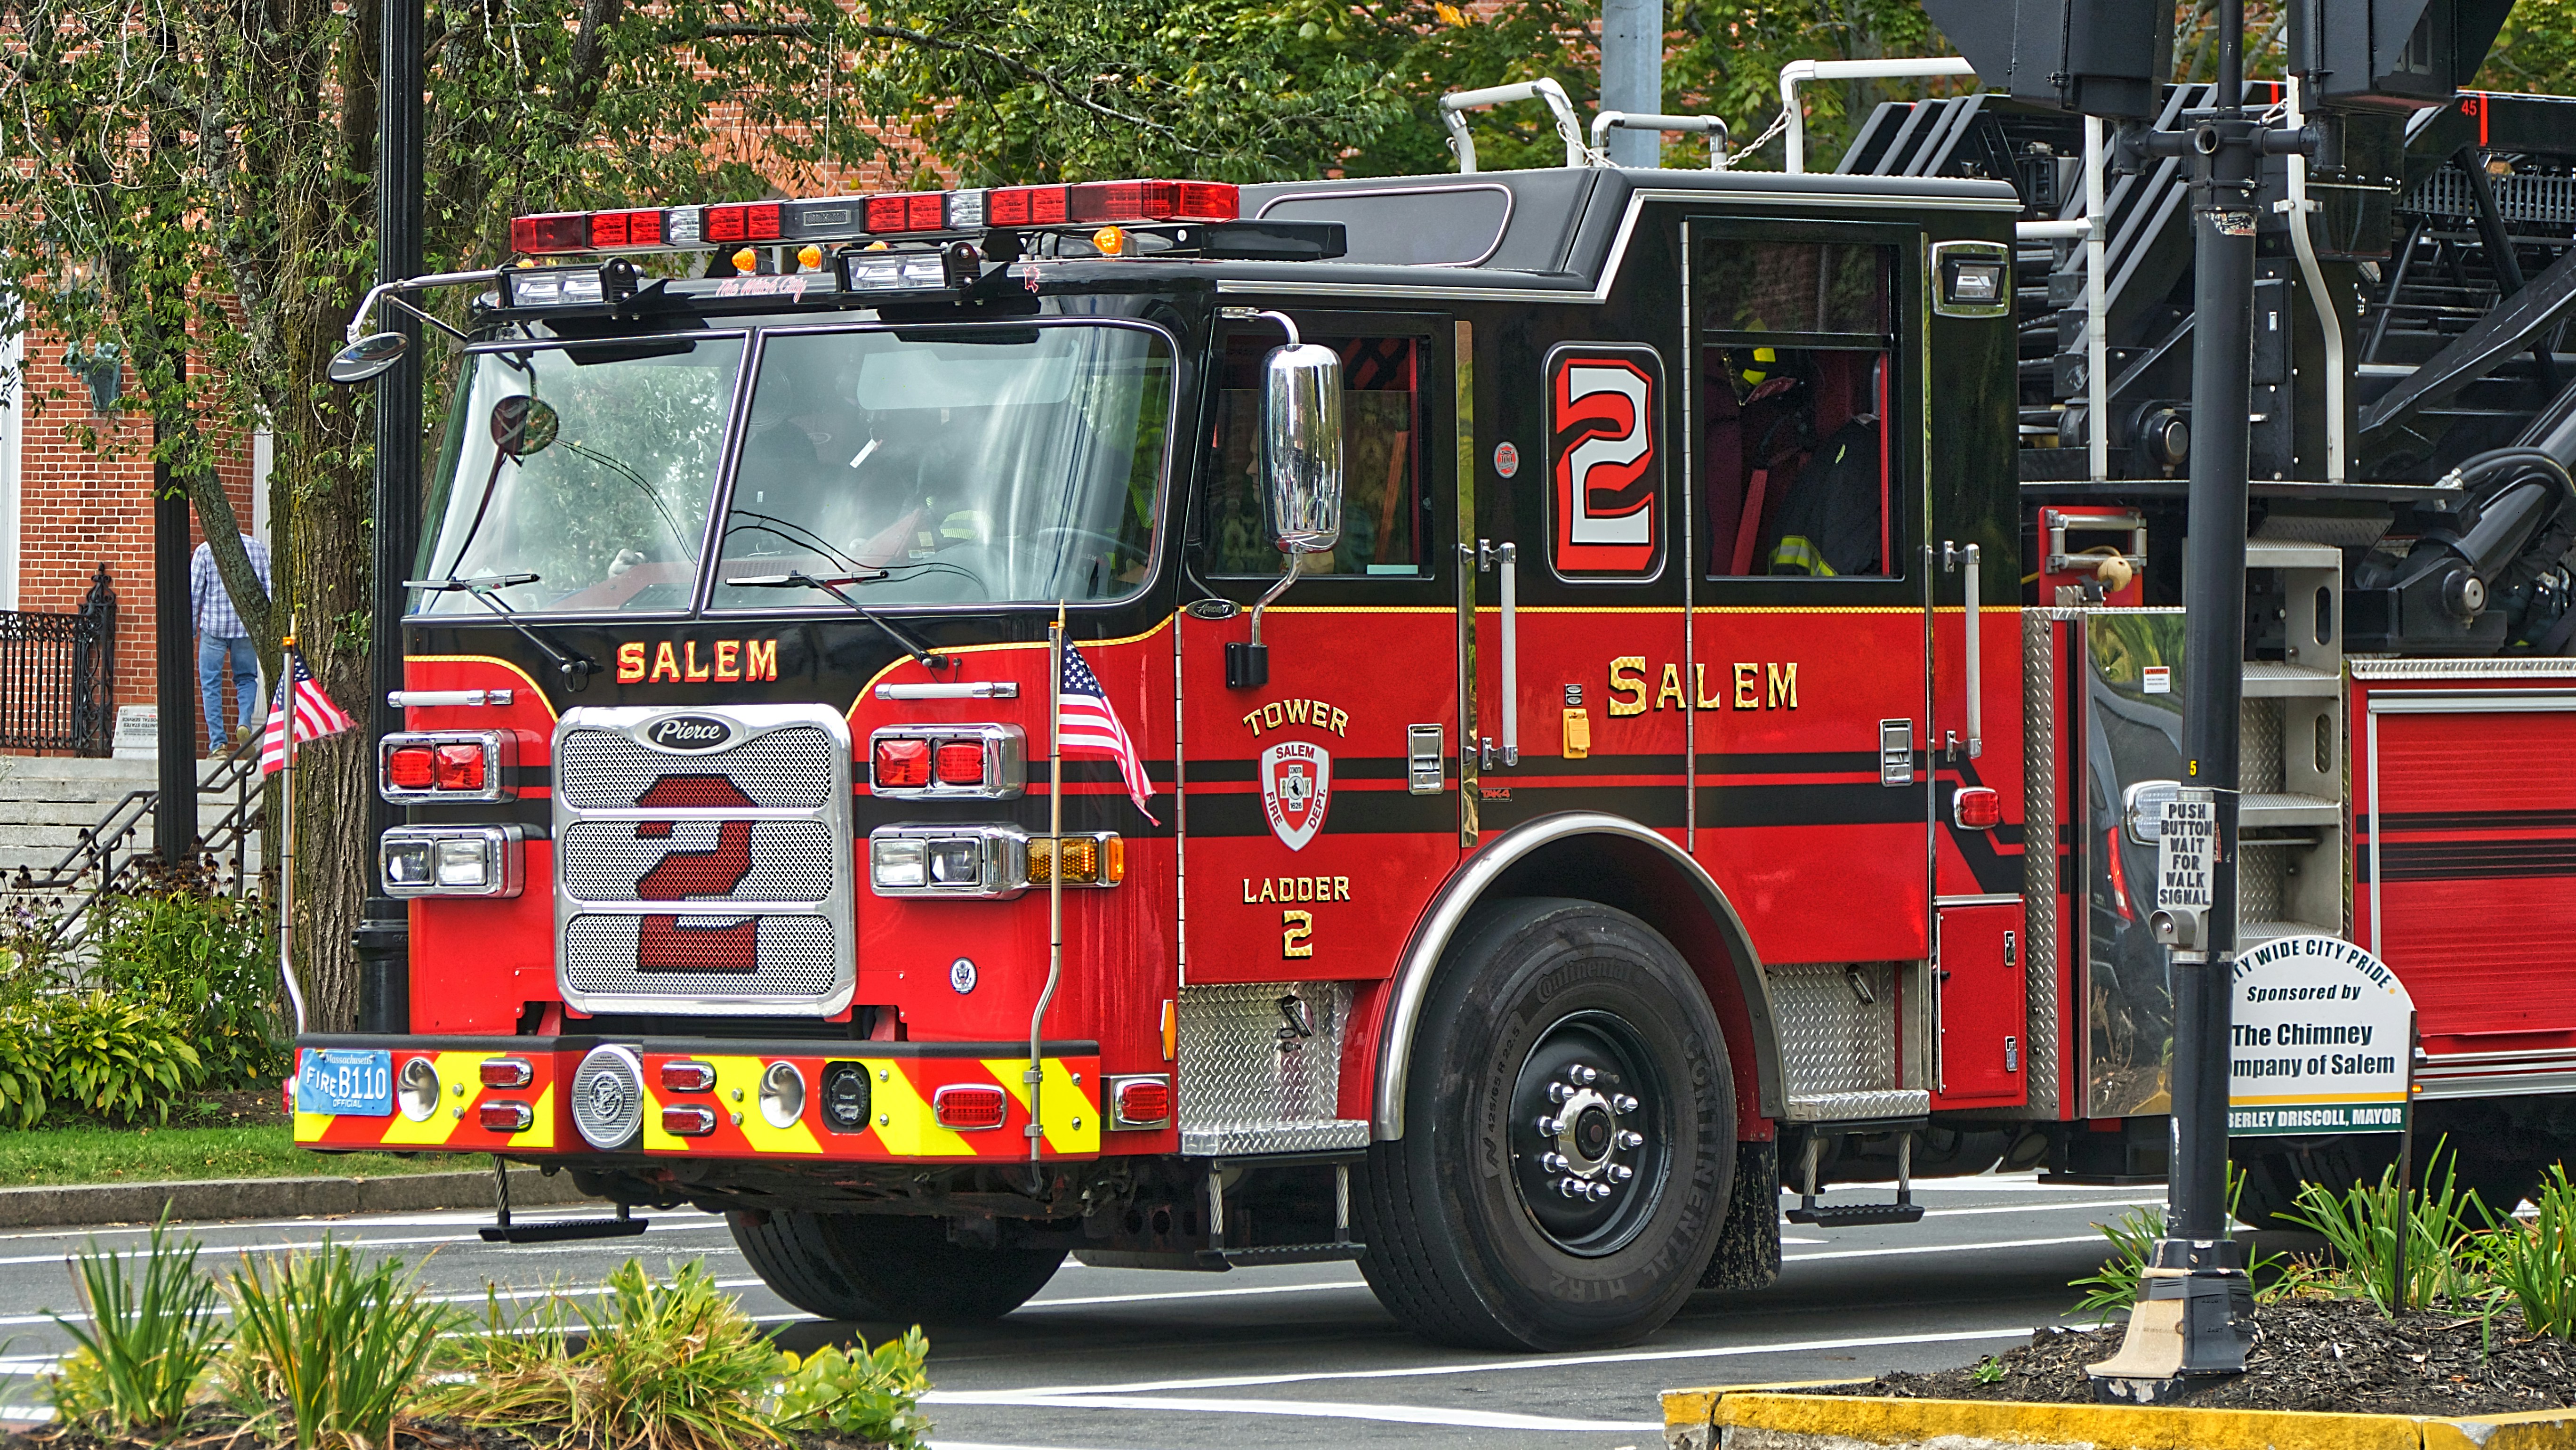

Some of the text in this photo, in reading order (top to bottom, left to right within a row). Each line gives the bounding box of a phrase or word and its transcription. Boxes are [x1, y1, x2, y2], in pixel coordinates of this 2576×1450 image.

[2462, 100, 2477, 116] 45
[716, 276, 807, 303] The Witch City
[1556, 358, 1654, 570] 2
[617, 639, 778, 683] SALEM
[1608, 656, 1798, 718] SALEM
[1242, 699, 1349, 738] TOWER
[657, 718, 721, 743] Pierce
[1276, 744, 1315, 760] SALEM
[2190, 760, 2197, 776] 5
[1266, 791, 1283, 827] FIRE
[1308, 789, 1326, 830] DEPT.
[2168, 804, 2206, 819] PUSH
[2161, 820, 2212, 836] BUTTON
[2170, 838, 2205, 853] WAIT
[635, 773, 758, 974] 2
[2172, 854, 2200, 870] FOR
[1243, 876, 1350, 903] LADDER
[2166, 872, 2205, 888] WALK
[2159, 889, 2211, 906] SIGNAL
[1283, 910, 1312, 960] 2
[2255, 941, 2300, 966] WIDE
[2306, 940, 2345, 959] CITY
[2346, 950, 2392, 989] PRIDE
[2247, 984, 2361, 1002] Sponsored by
[2232, 1023, 2373, 1046] The Chimney
[325, 1054, 373, 1065] Massachusetts
[2307, 1055, 2327, 1075] of
[2332, 1054, 2395, 1075] Salem
[306, 1066, 386, 1100] FIRE B110
[1488, 1026, 1521, 1133] 425/65 R 22.5
[333, 1099, 362, 1108] OFFICIAL
[2278, 1110, 2350, 1127] DRISCOLL,
[2352, 1108, 2402, 1124] MAYOR
